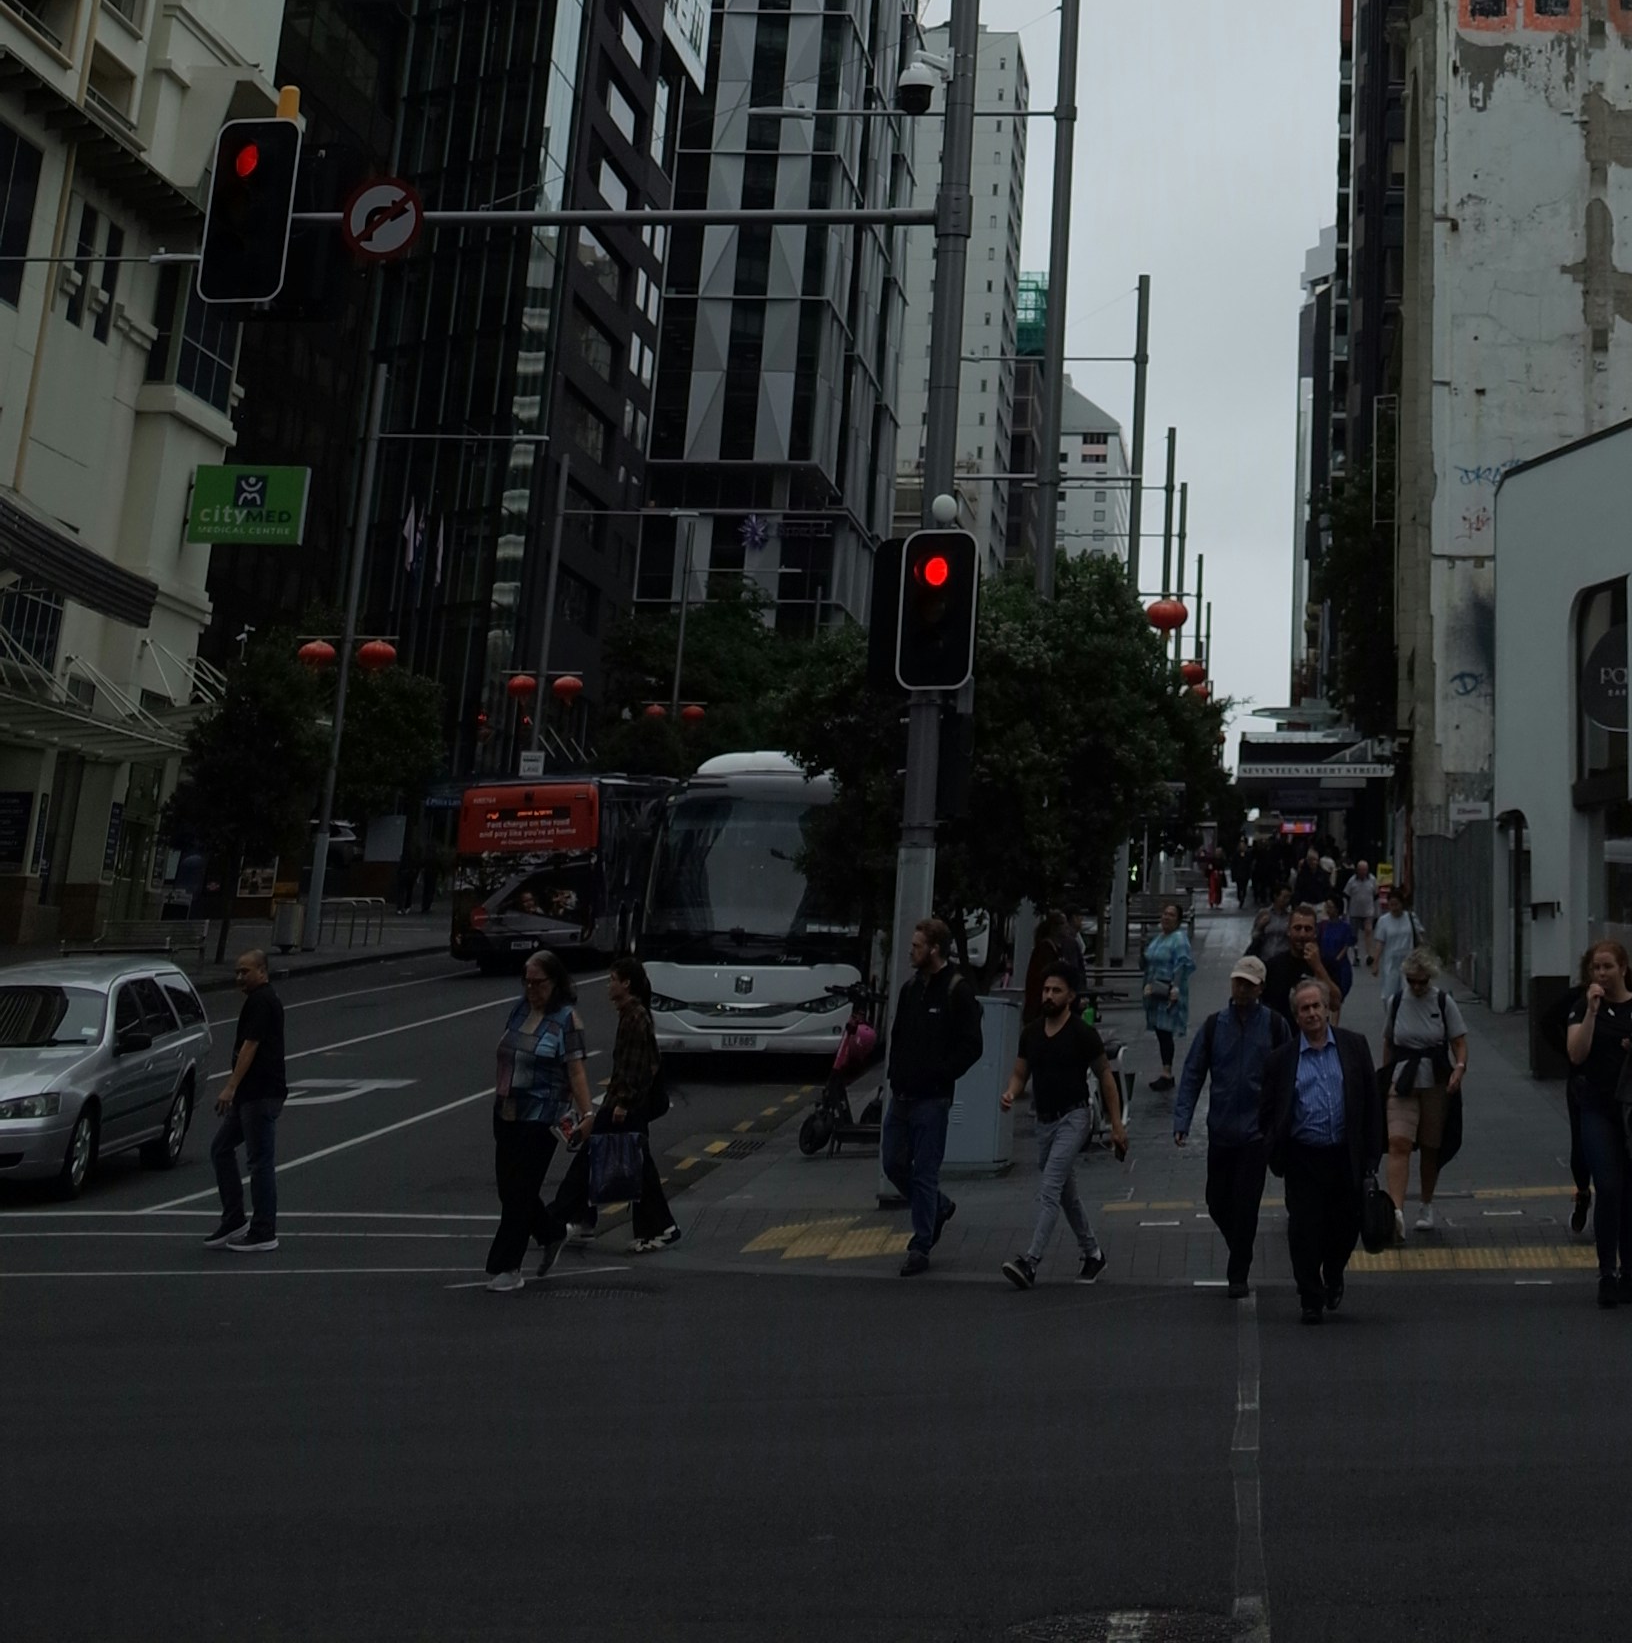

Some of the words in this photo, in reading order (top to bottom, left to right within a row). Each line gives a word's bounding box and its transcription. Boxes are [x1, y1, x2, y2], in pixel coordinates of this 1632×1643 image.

[197, 526, 246, 535] MEDICAL
[248, 527, 290, 535] CENTRE
[1242, 767, 1300, 775] SEVENTEEN
[1303, 767, 1342, 775] ALBERT
[1346, 767, 1385, 775] STREET
